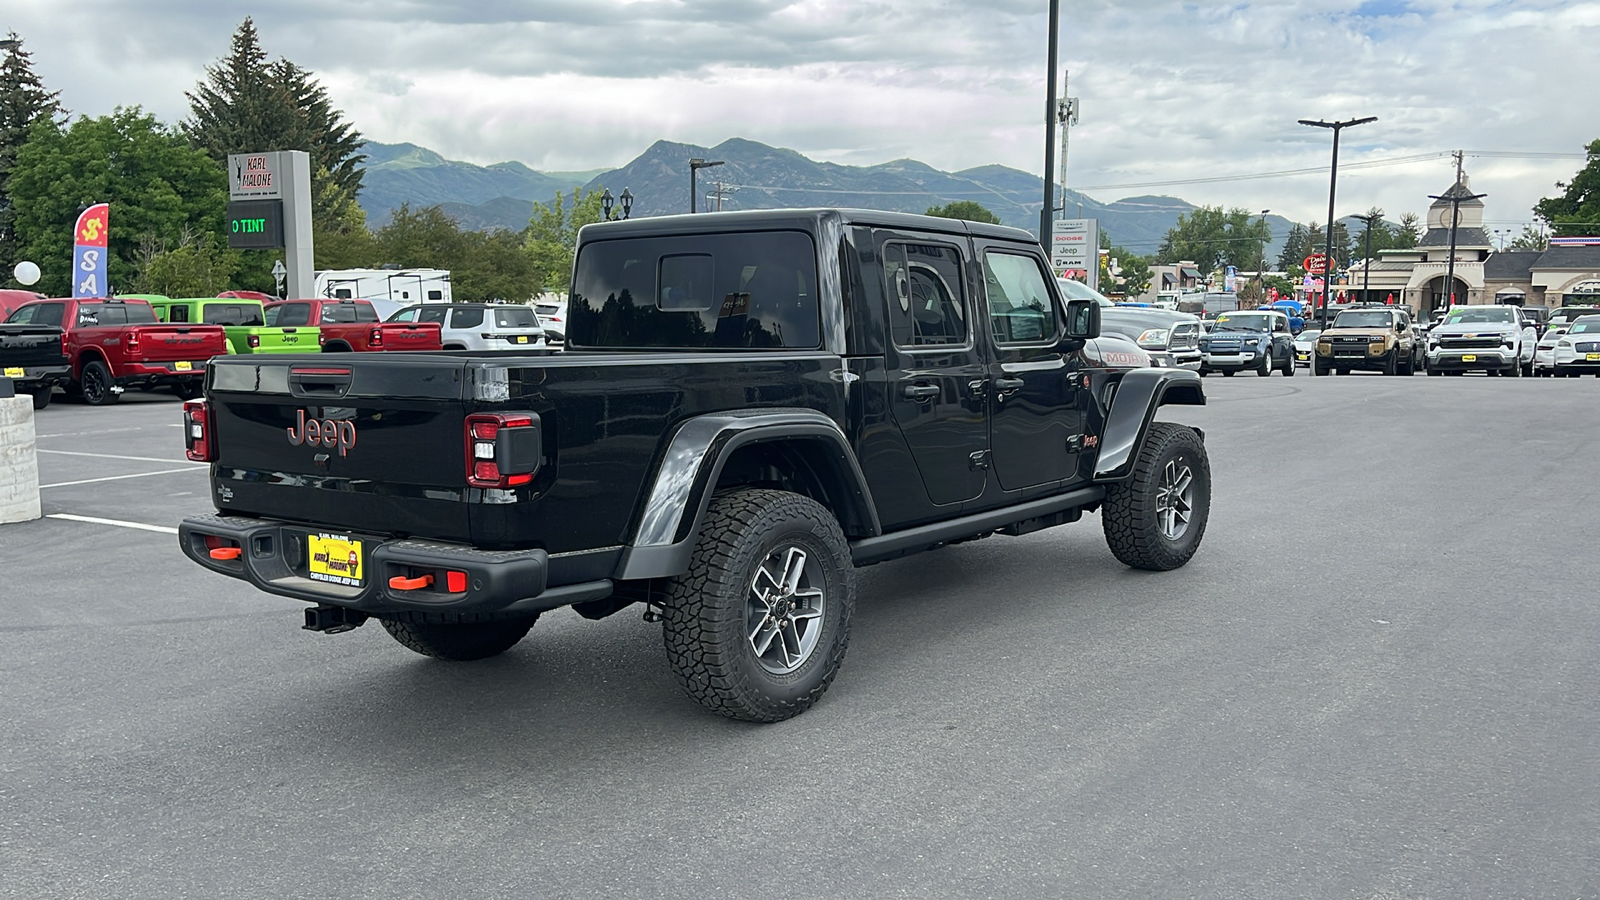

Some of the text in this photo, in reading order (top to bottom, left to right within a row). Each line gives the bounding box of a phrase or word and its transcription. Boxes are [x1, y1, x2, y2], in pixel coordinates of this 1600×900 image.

[247, 156, 266, 171] KARL
[242, 173, 272, 188] MALONE
[241, 218, 265, 233] TINT
[1060, 247, 1077, 255] Jeep
[287, 409, 356, 457] Jeep
[1084, 434, 1098, 448] Jeep
[314, 553, 326, 562] KARL
[329, 561, 348, 571] MALONE
[310, 572, 328, 580] CHRYSLER
[329, 575, 342, 583] DODGE
